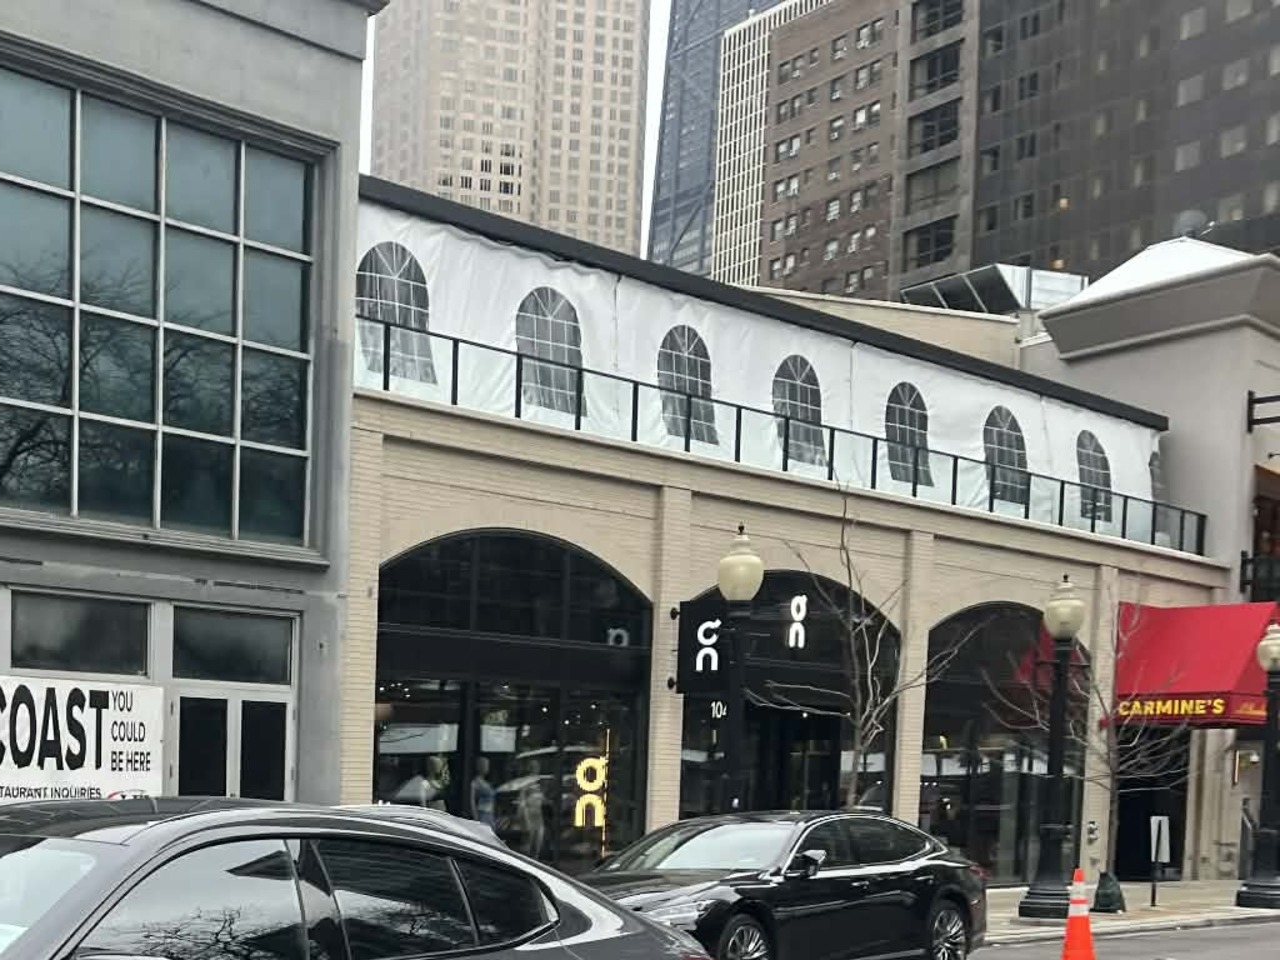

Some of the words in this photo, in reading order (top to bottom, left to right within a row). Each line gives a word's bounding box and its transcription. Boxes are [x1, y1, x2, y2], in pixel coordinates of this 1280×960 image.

[111, 690, 133, 712] YOU
[1119, 698, 1226, 717] CARMINE'S
[111, 720, 146, 742] COULD
[111, 750, 123, 772] BE
[125, 751, 151, 772] HERE
